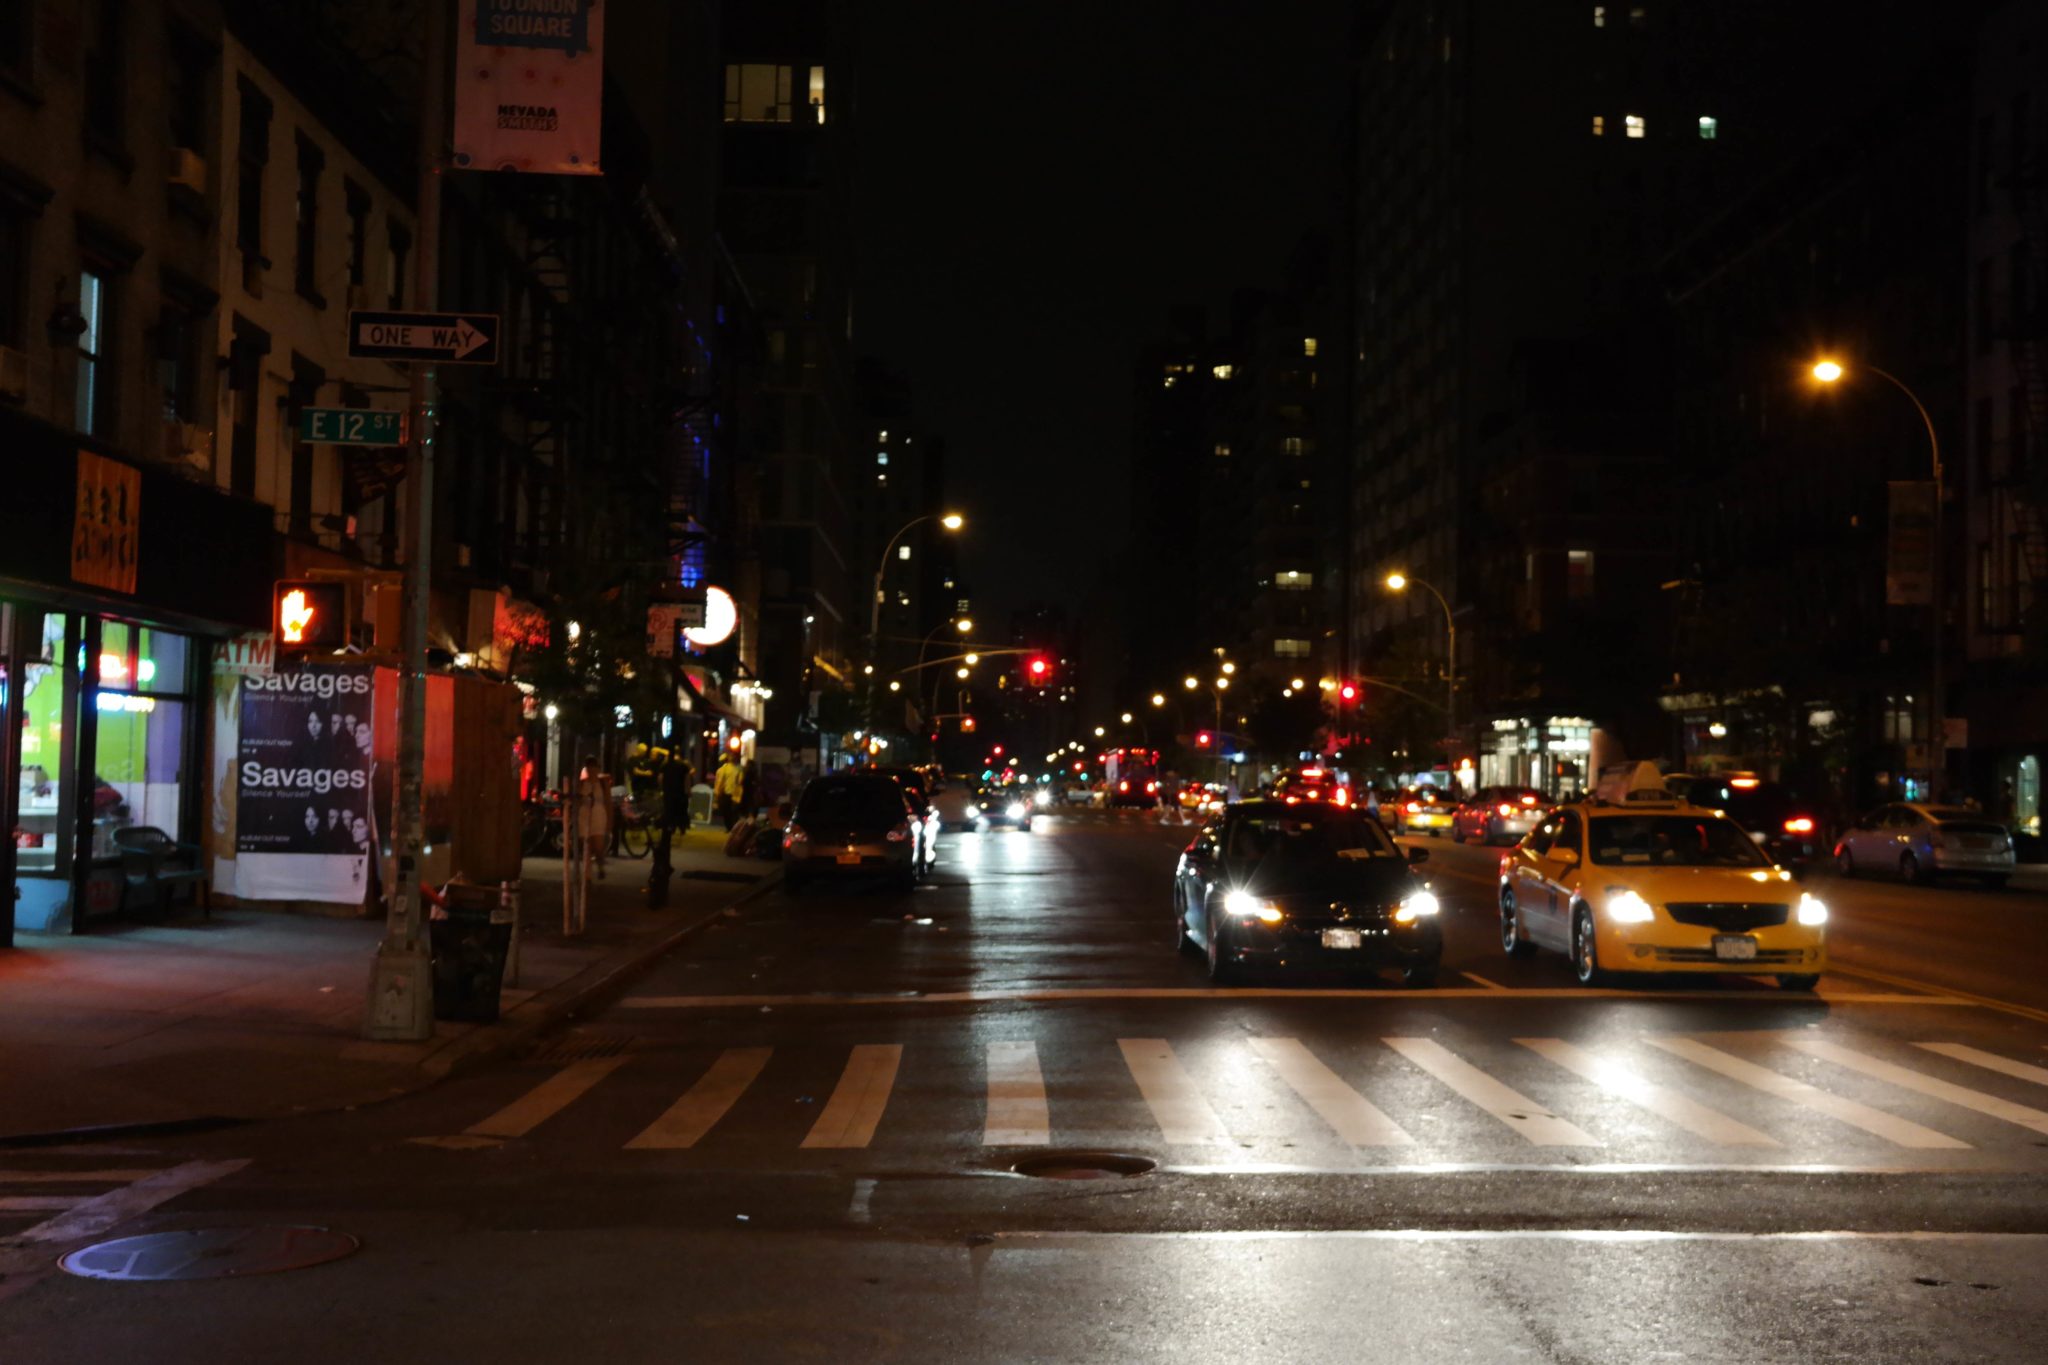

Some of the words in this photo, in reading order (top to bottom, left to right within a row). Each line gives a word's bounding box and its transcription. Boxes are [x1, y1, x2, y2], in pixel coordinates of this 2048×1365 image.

[491, 15, 572, 37] SQUARE
[498, 105, 557, 117] NEVADA
[371, 326, 412, 345] ONE
[432, 329, 474, 348] WAY
[311, 412, 327, 439] E
[338, 414, 365, 441] 12
[374, 415, 394, 430] ST
[216, 639, 272, 664] ATM
[245, 673, 369, 698] Savages
[242, 761, 366, 794] Savages
